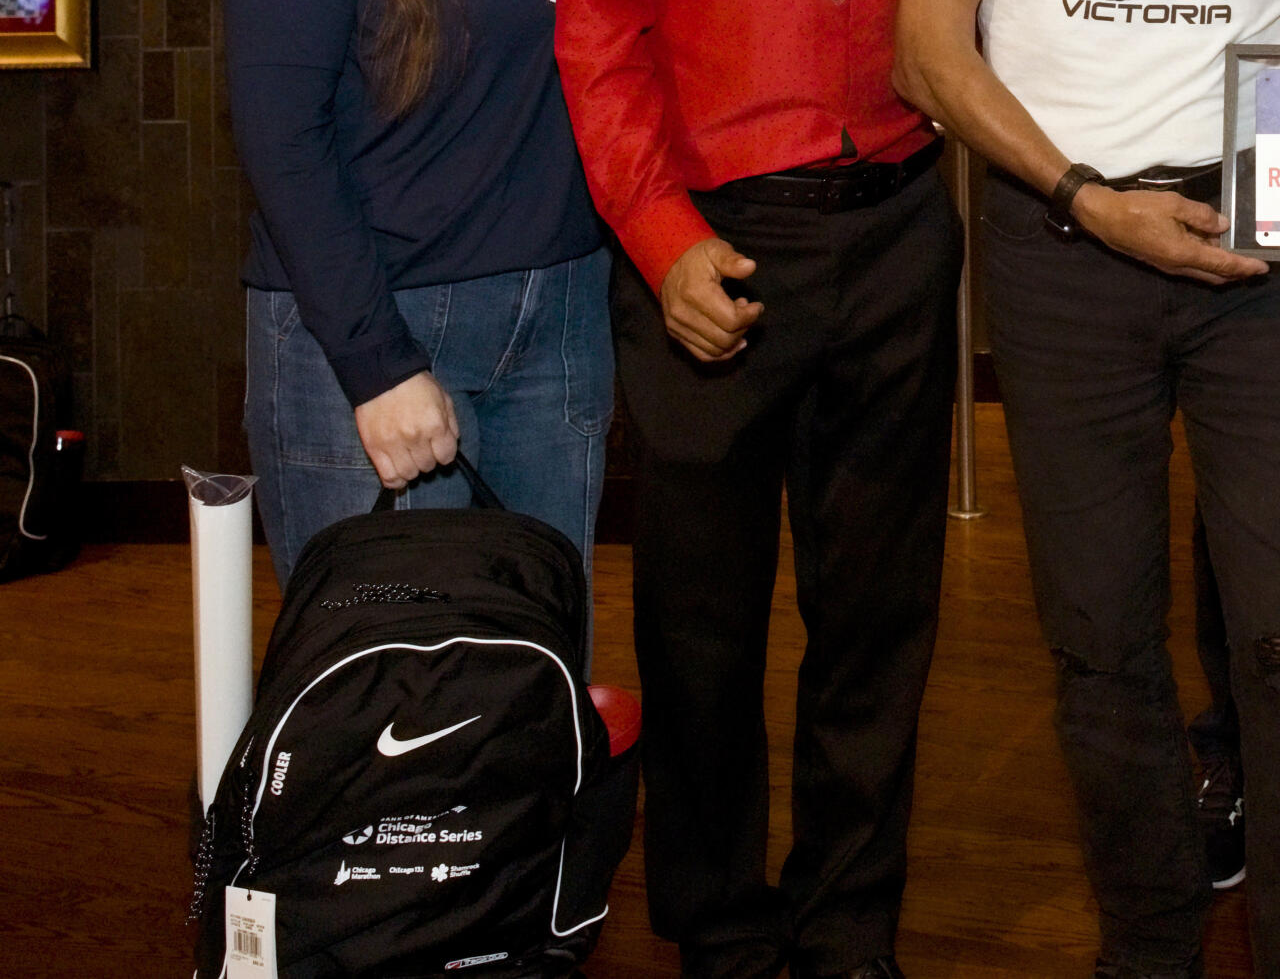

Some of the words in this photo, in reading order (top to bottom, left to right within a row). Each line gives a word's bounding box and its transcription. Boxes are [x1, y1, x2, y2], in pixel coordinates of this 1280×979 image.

[270, 751, 292, 796] COOLER
[378, 822, 433, 833] Chicago
[375, 832, 437, 844] Distance
[439, 829, 483, 843] Series
[351, 866, 377, 875] Chicago
